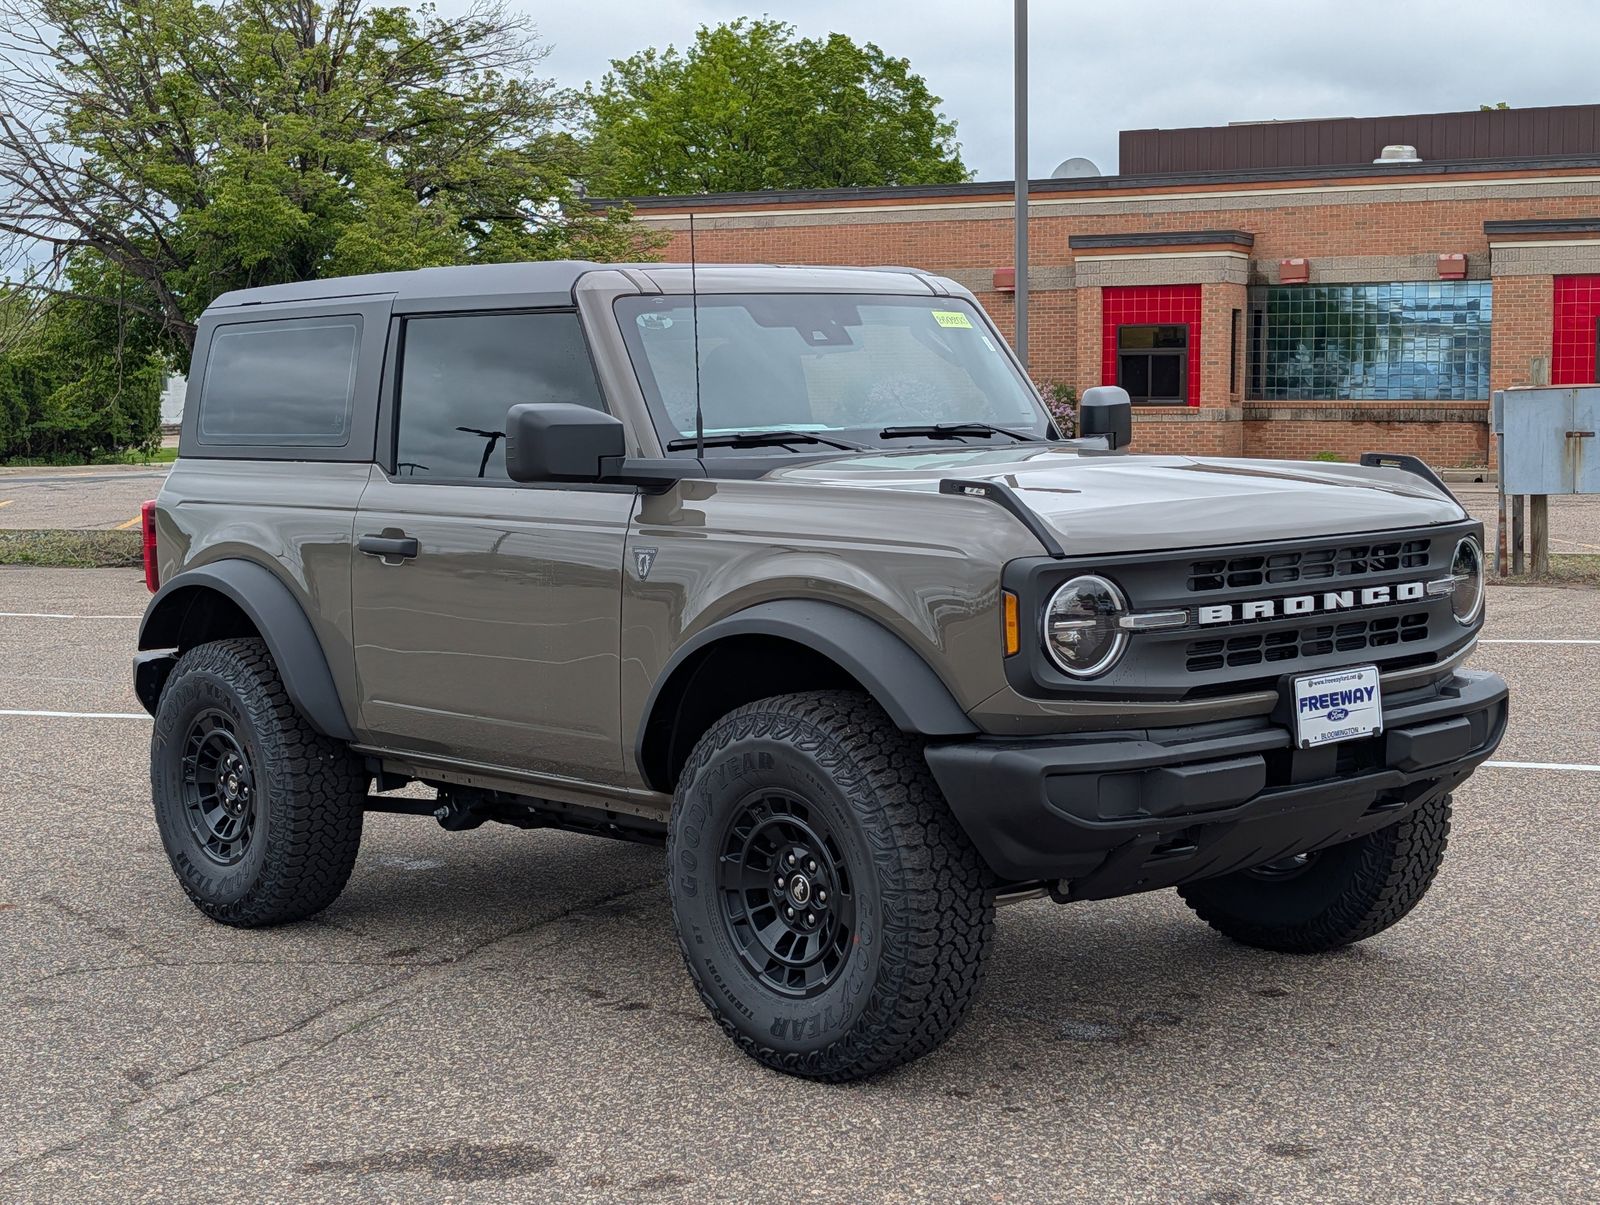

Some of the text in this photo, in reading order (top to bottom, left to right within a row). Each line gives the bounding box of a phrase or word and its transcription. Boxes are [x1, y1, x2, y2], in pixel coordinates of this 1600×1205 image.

[1199, 582, 1424, 625] BRONCO
[1299, 685, 1375, 713] FREEWAY
[1330, 709, 1345, 720] Ford
[1320, 727, 1359, 740] BLOOMINGTON
[703, 958, 755, 1020] TERRITORY
